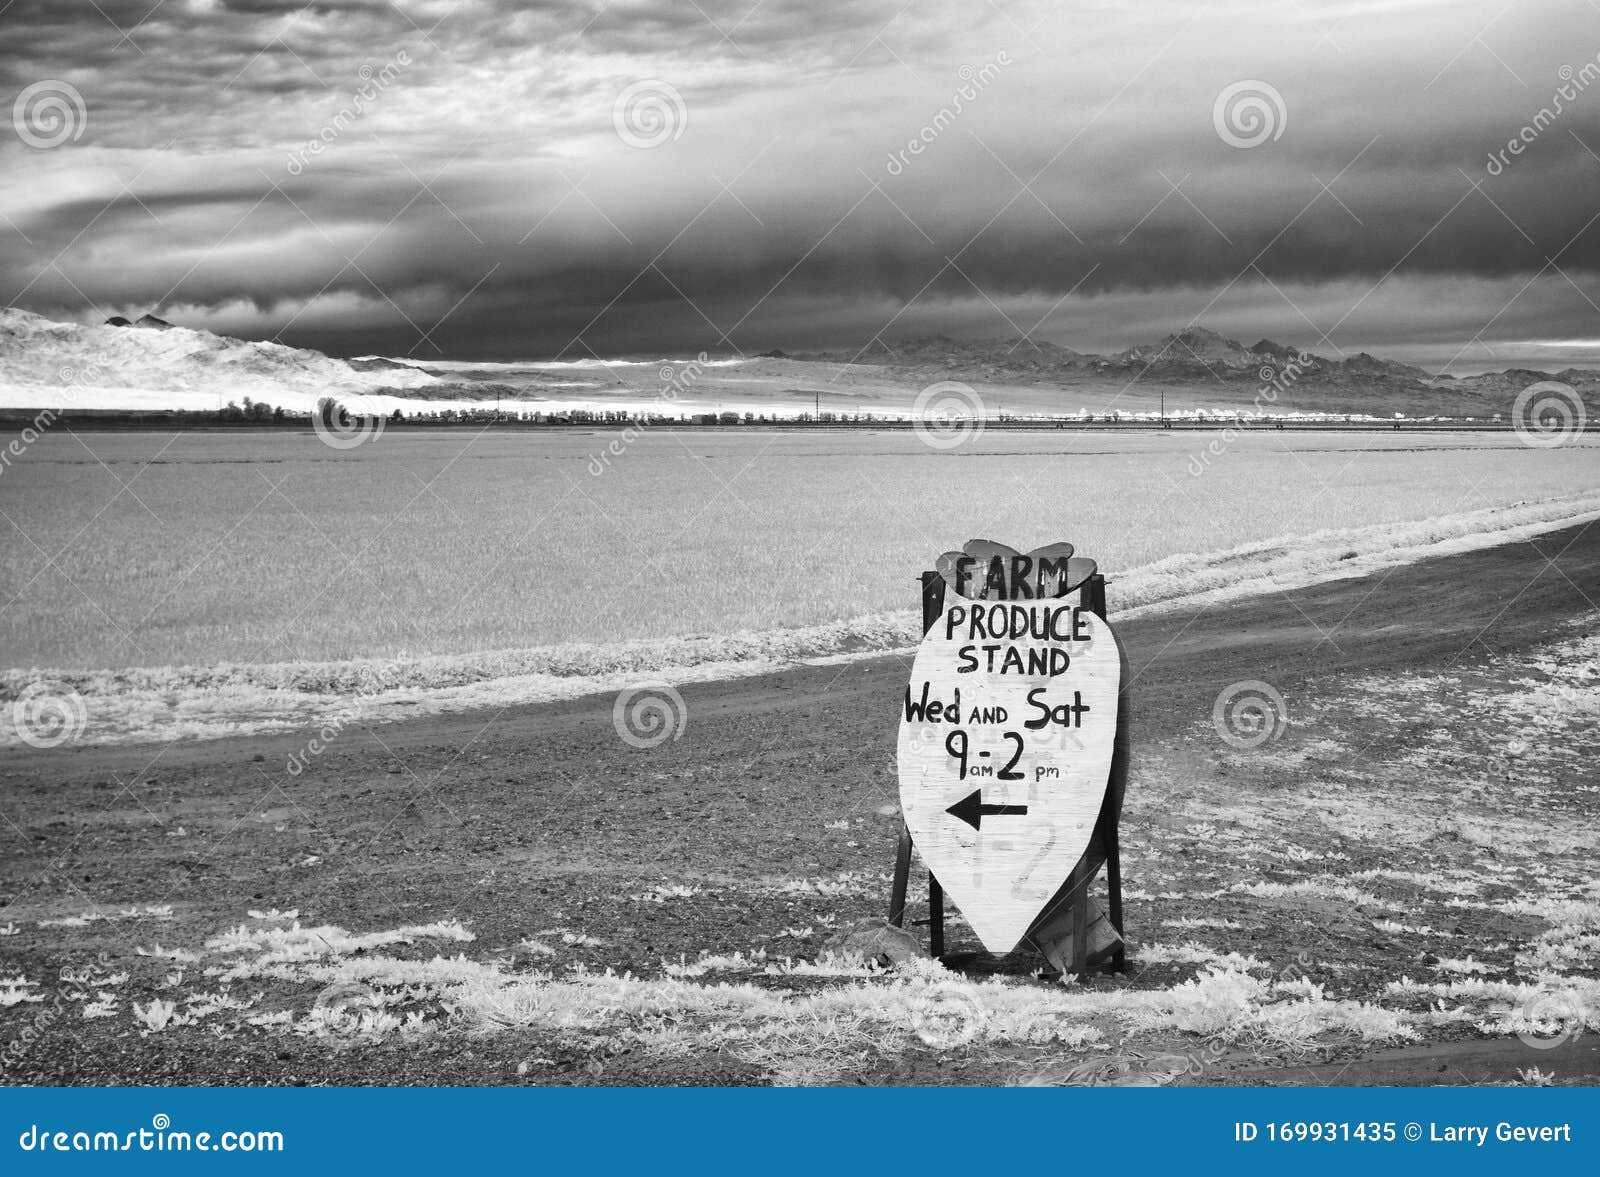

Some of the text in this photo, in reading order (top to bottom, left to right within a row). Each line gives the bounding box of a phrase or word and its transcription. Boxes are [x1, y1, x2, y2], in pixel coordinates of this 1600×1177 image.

[956, 555, 1068, 600] FARM
[946, 604, 1091, 641] PRODUCE
[957, 645, 1070, 677] STAND
[905, 680, 1090, 730] Wed AND Sat
[1035, 766, 1060, 783] pm
